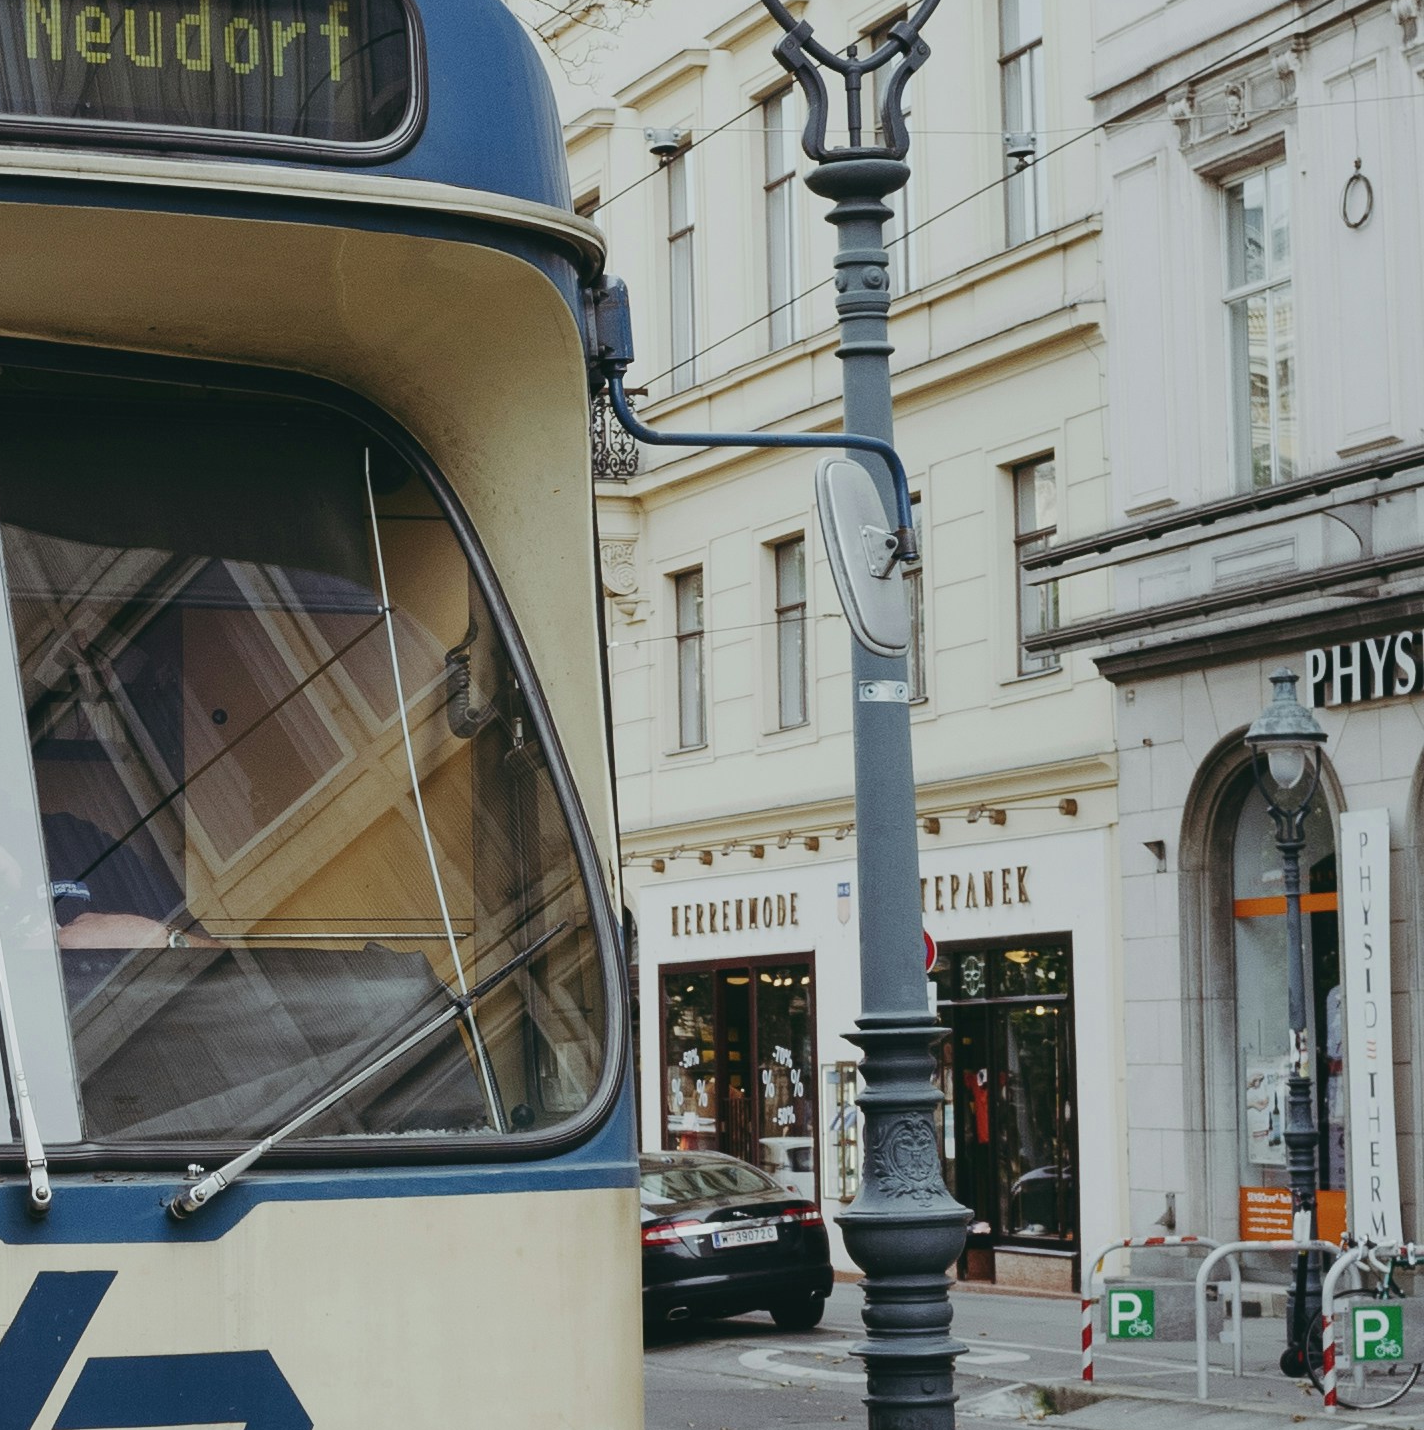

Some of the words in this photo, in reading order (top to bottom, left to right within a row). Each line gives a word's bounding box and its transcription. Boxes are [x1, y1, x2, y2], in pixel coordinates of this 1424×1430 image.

[1305, 628, 1424, 709] PHYS
[671, 892, 799, 936] HERRENMODE
[921, 865, 1031, 914] TEPANEK
[1111, 1293, 1142, 1336] P
[1355, 1310, 1390, 1358] P
